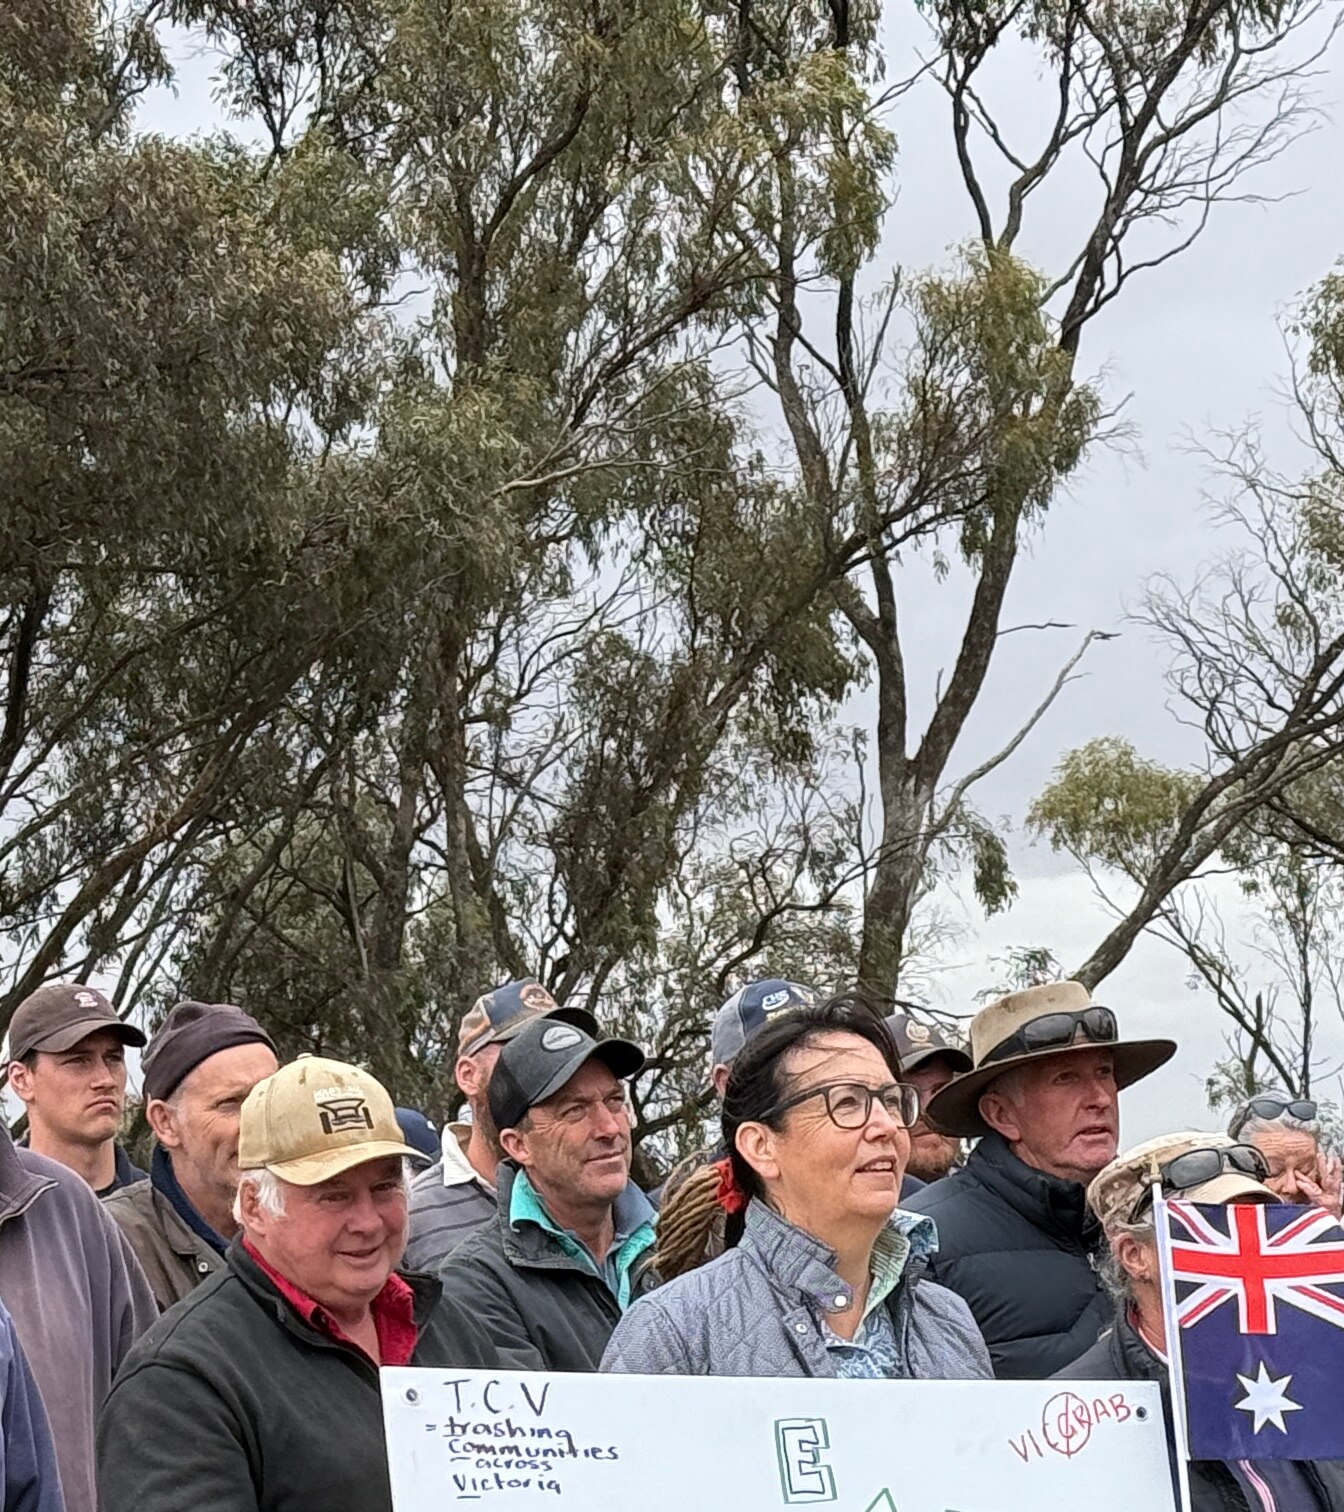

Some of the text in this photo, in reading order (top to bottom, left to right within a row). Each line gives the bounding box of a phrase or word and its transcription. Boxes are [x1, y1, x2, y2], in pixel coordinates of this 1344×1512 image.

[443, 1416, 574, 1450] trashing
[475, 1458, 554, 1471] across
[775, 1418, 837, 1504] E
[452, 1473, 562, 1494] Victoria
